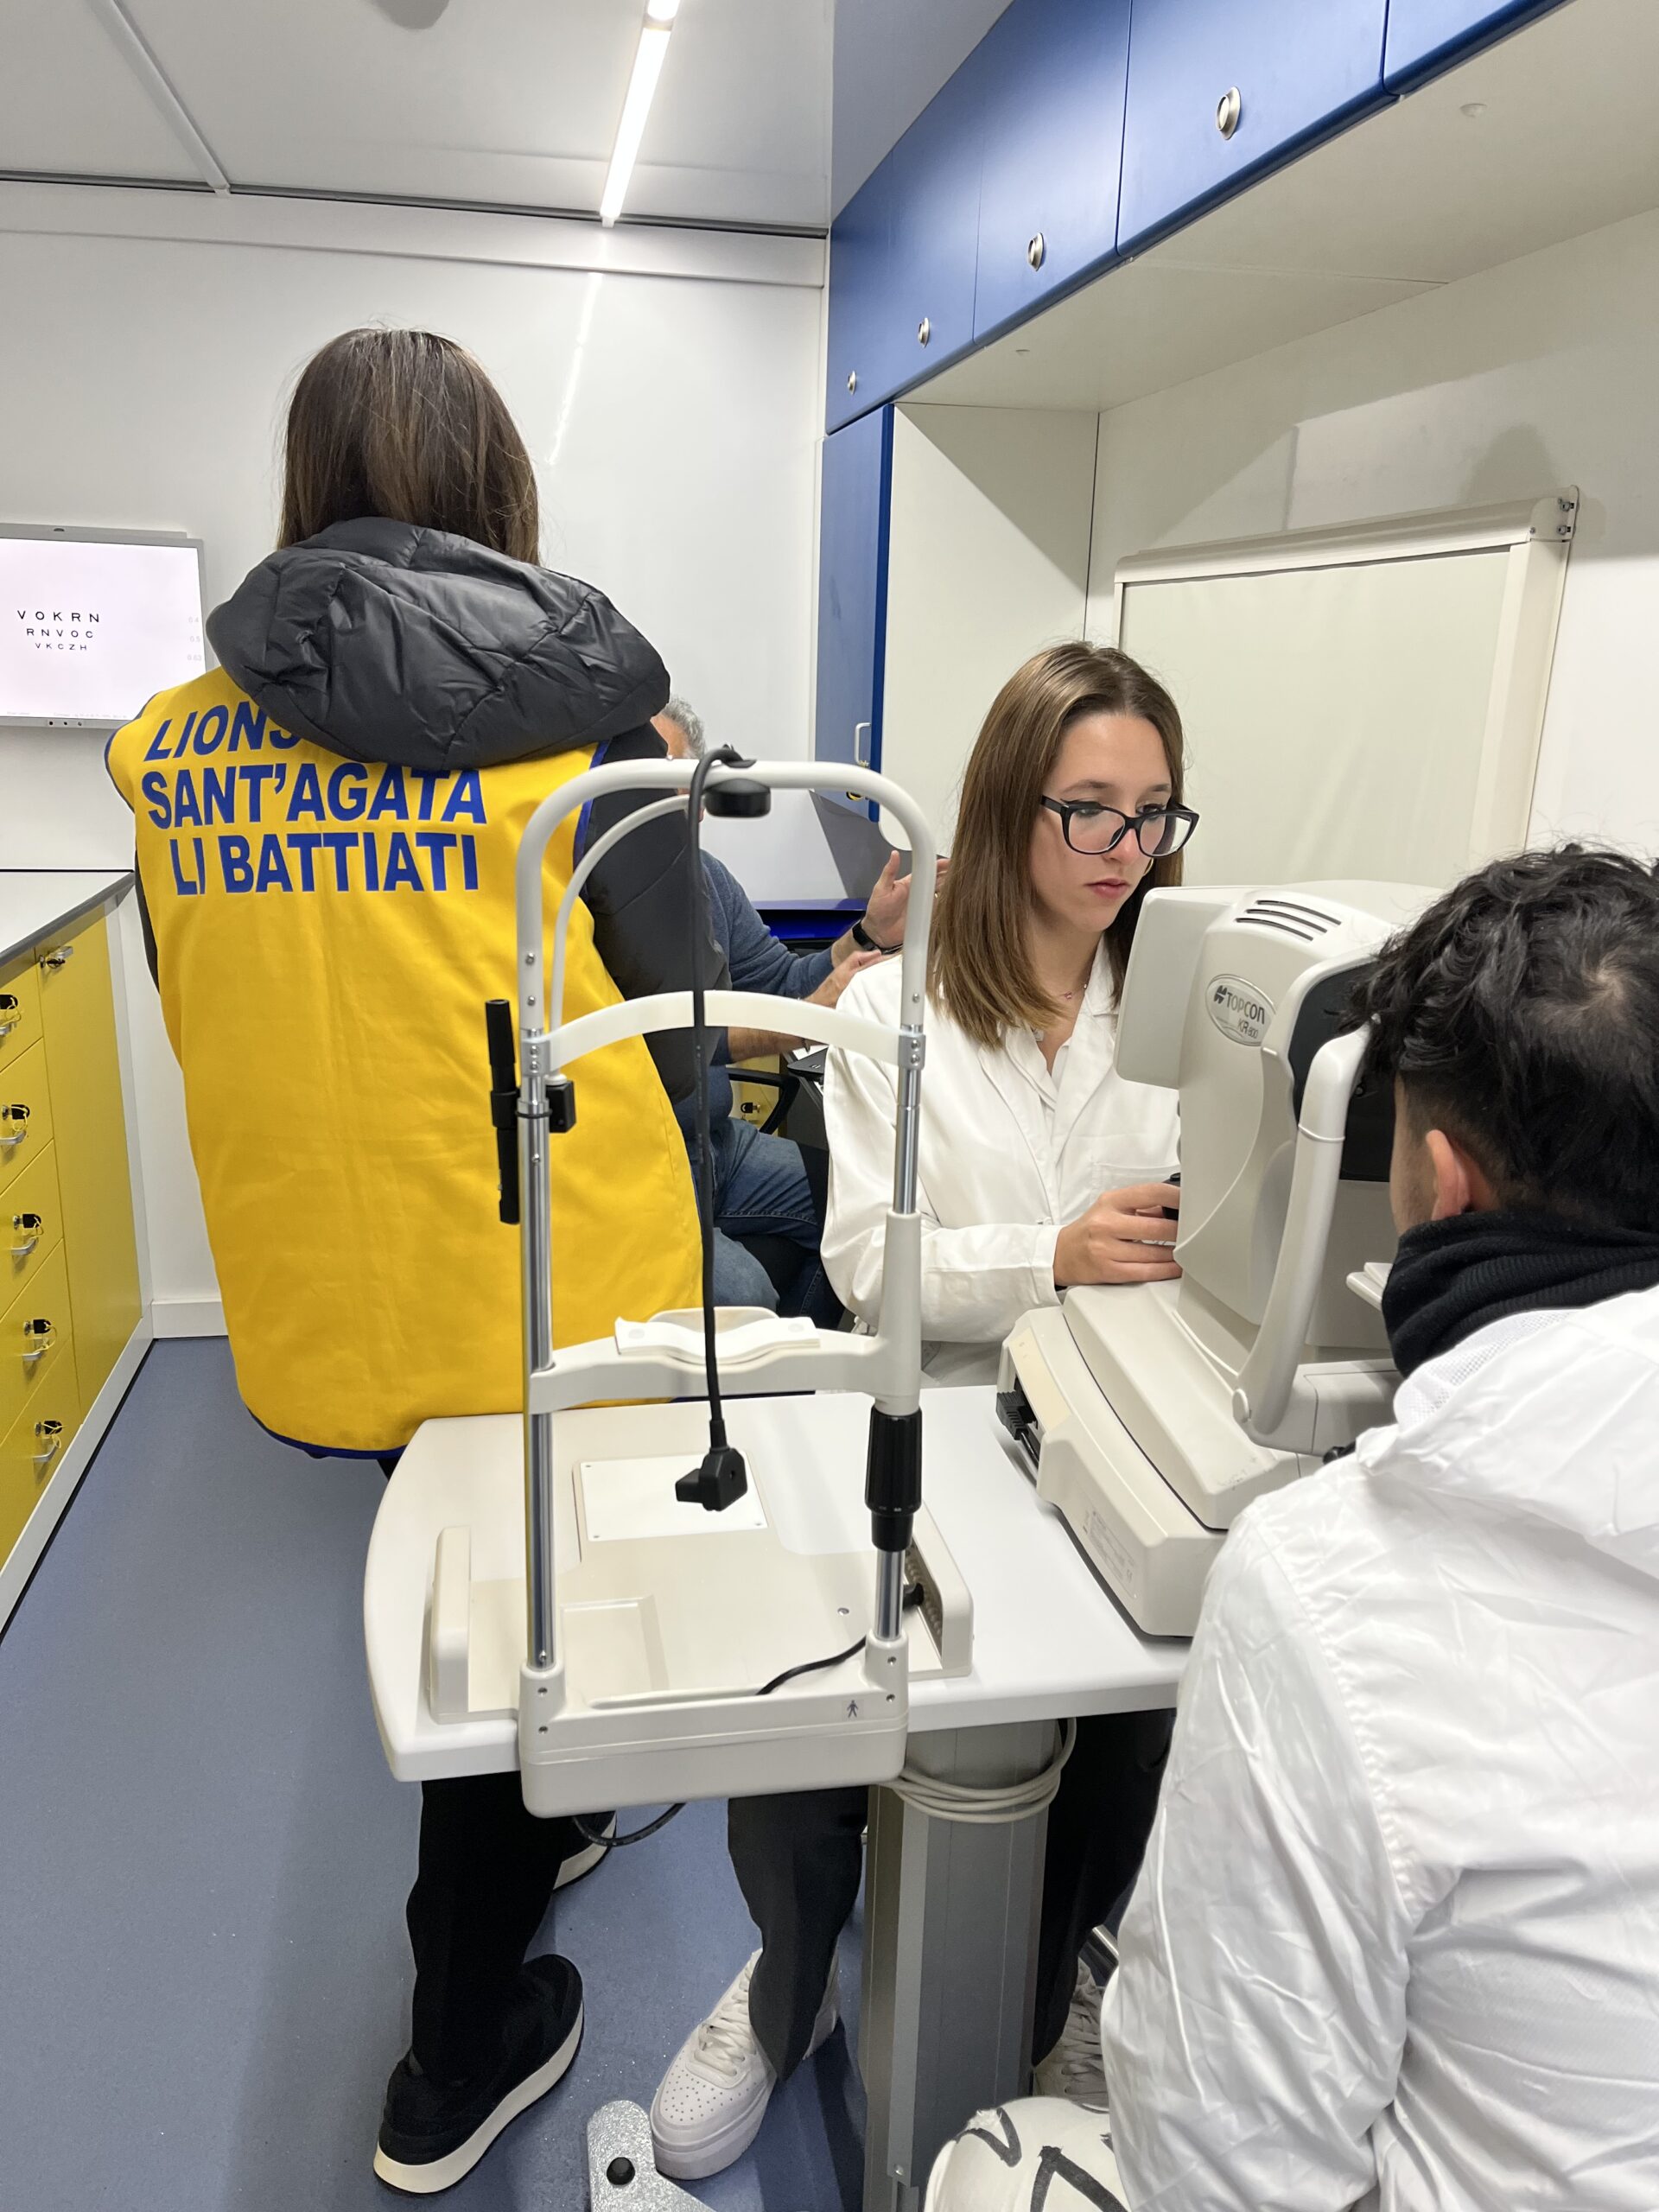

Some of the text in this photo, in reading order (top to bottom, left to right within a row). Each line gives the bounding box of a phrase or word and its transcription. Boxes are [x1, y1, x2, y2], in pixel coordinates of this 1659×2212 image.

[142, 762, 487, 830] SANT'AGATA
[169, 831, 479, 896] LI BATTIATI
[1227, 992, 1265, 1025] TOPCON
